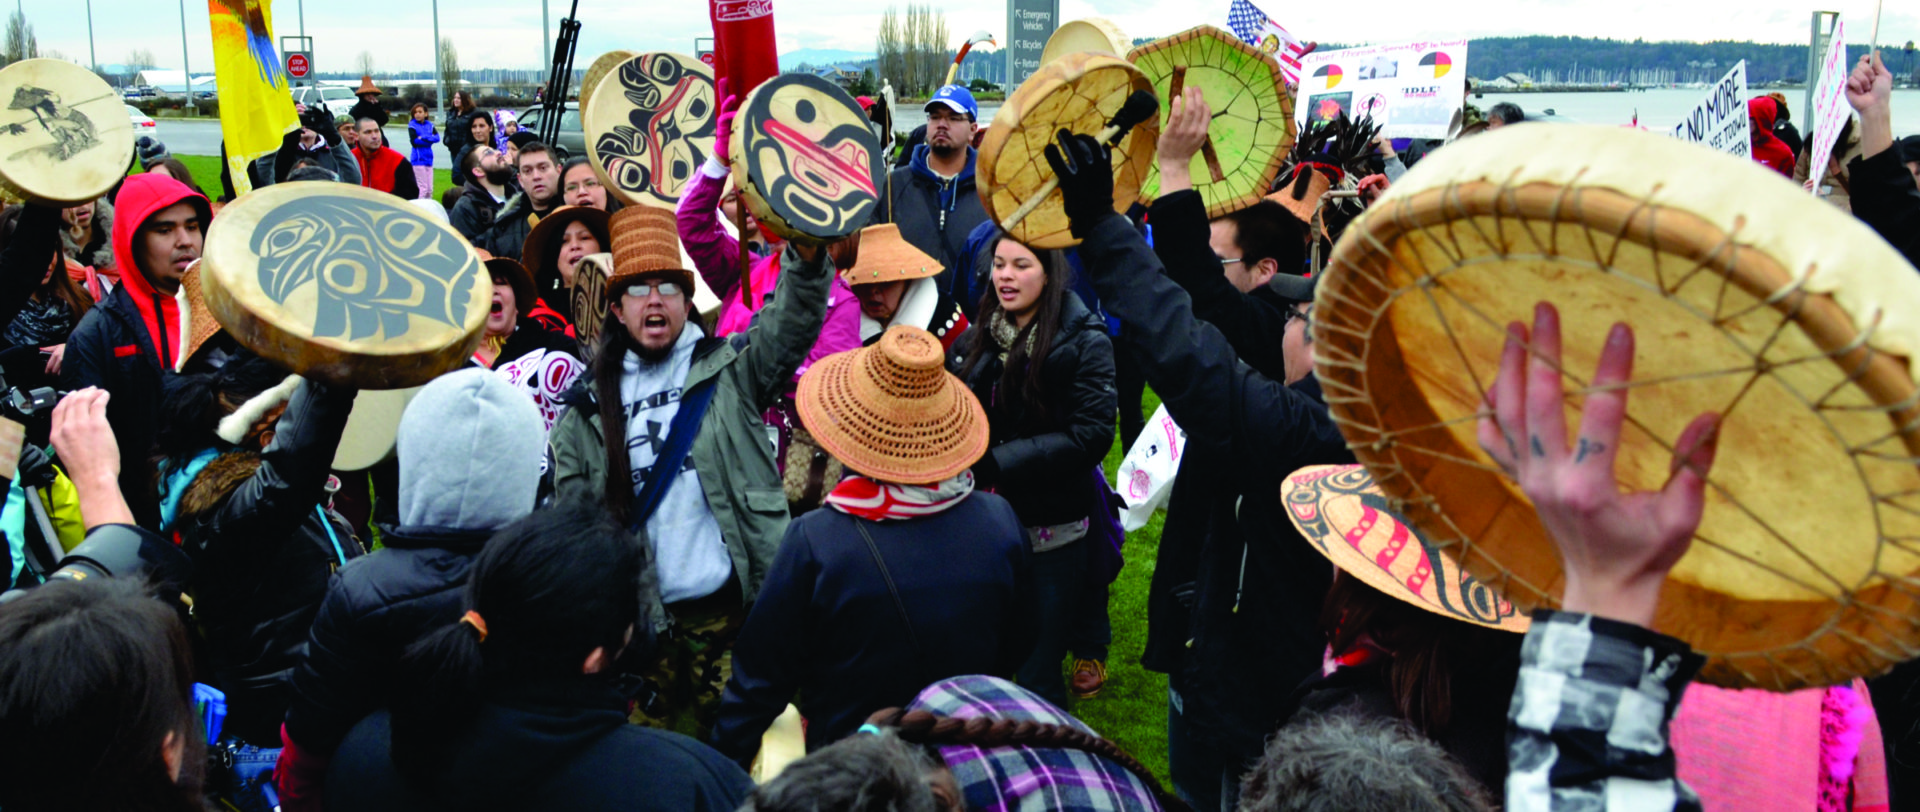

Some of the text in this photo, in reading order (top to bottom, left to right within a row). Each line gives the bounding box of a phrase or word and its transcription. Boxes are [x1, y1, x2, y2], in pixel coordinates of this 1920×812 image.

[1022, 10, 1051, 21] Emergency
[1022, 21, 1044, 30] Vehicles
[1022, 40, 1043, 51] Bicycles
[1022, 59, 1040, 68] Return
[1307, 53, 1334, 64] Chief
[1687, 70, 1741, 142] NO MORE
